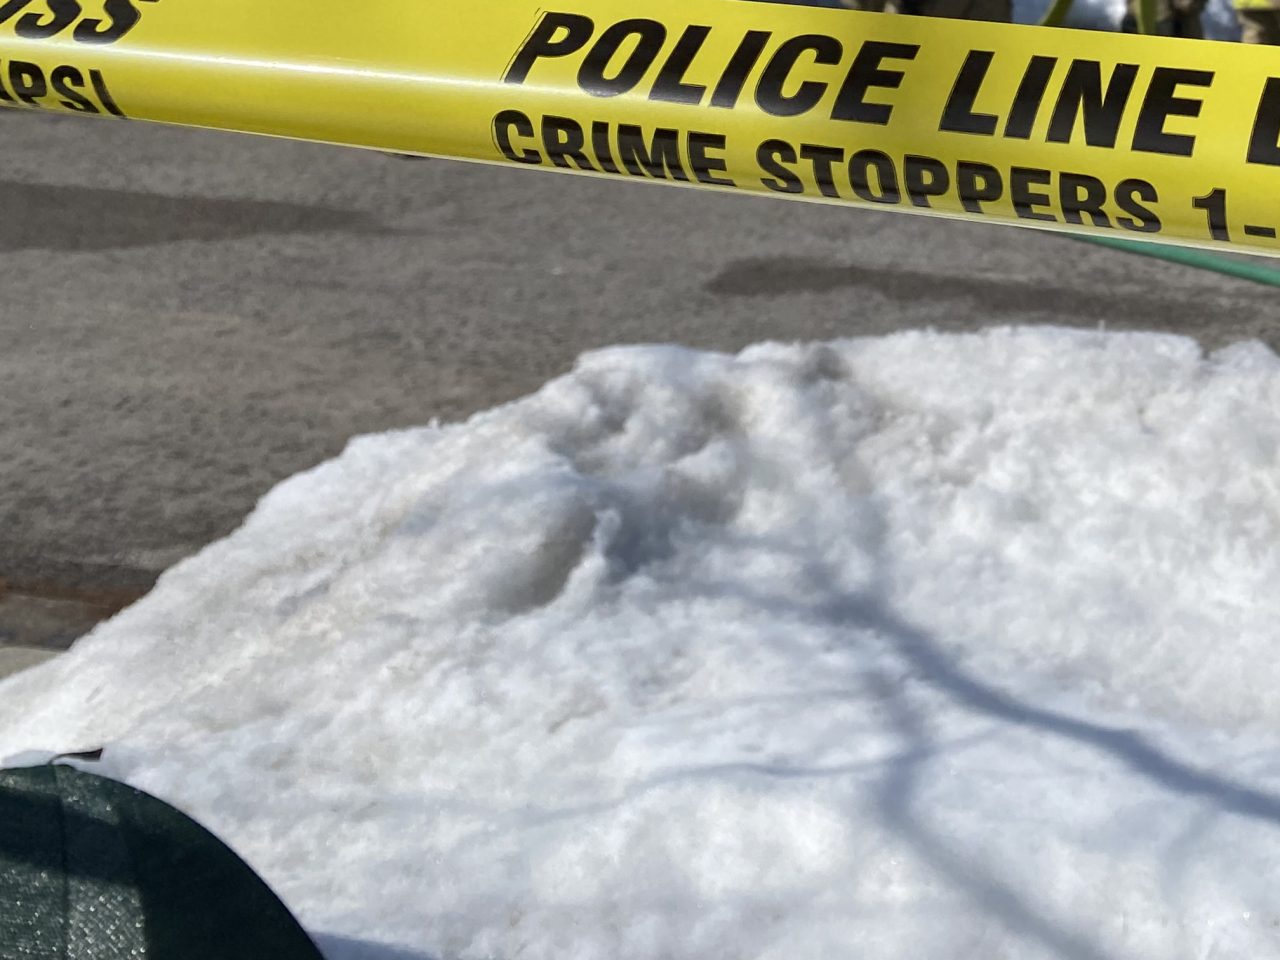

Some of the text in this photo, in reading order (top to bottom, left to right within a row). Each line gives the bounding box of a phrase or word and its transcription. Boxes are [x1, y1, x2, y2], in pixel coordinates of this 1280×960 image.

[501, 11, 920, 126] POLICE
[938, 50, 1215, 157] LINE
[492, 109, 738, 188] CRIME
[755, 138, 1162, 233] STOPPERS
